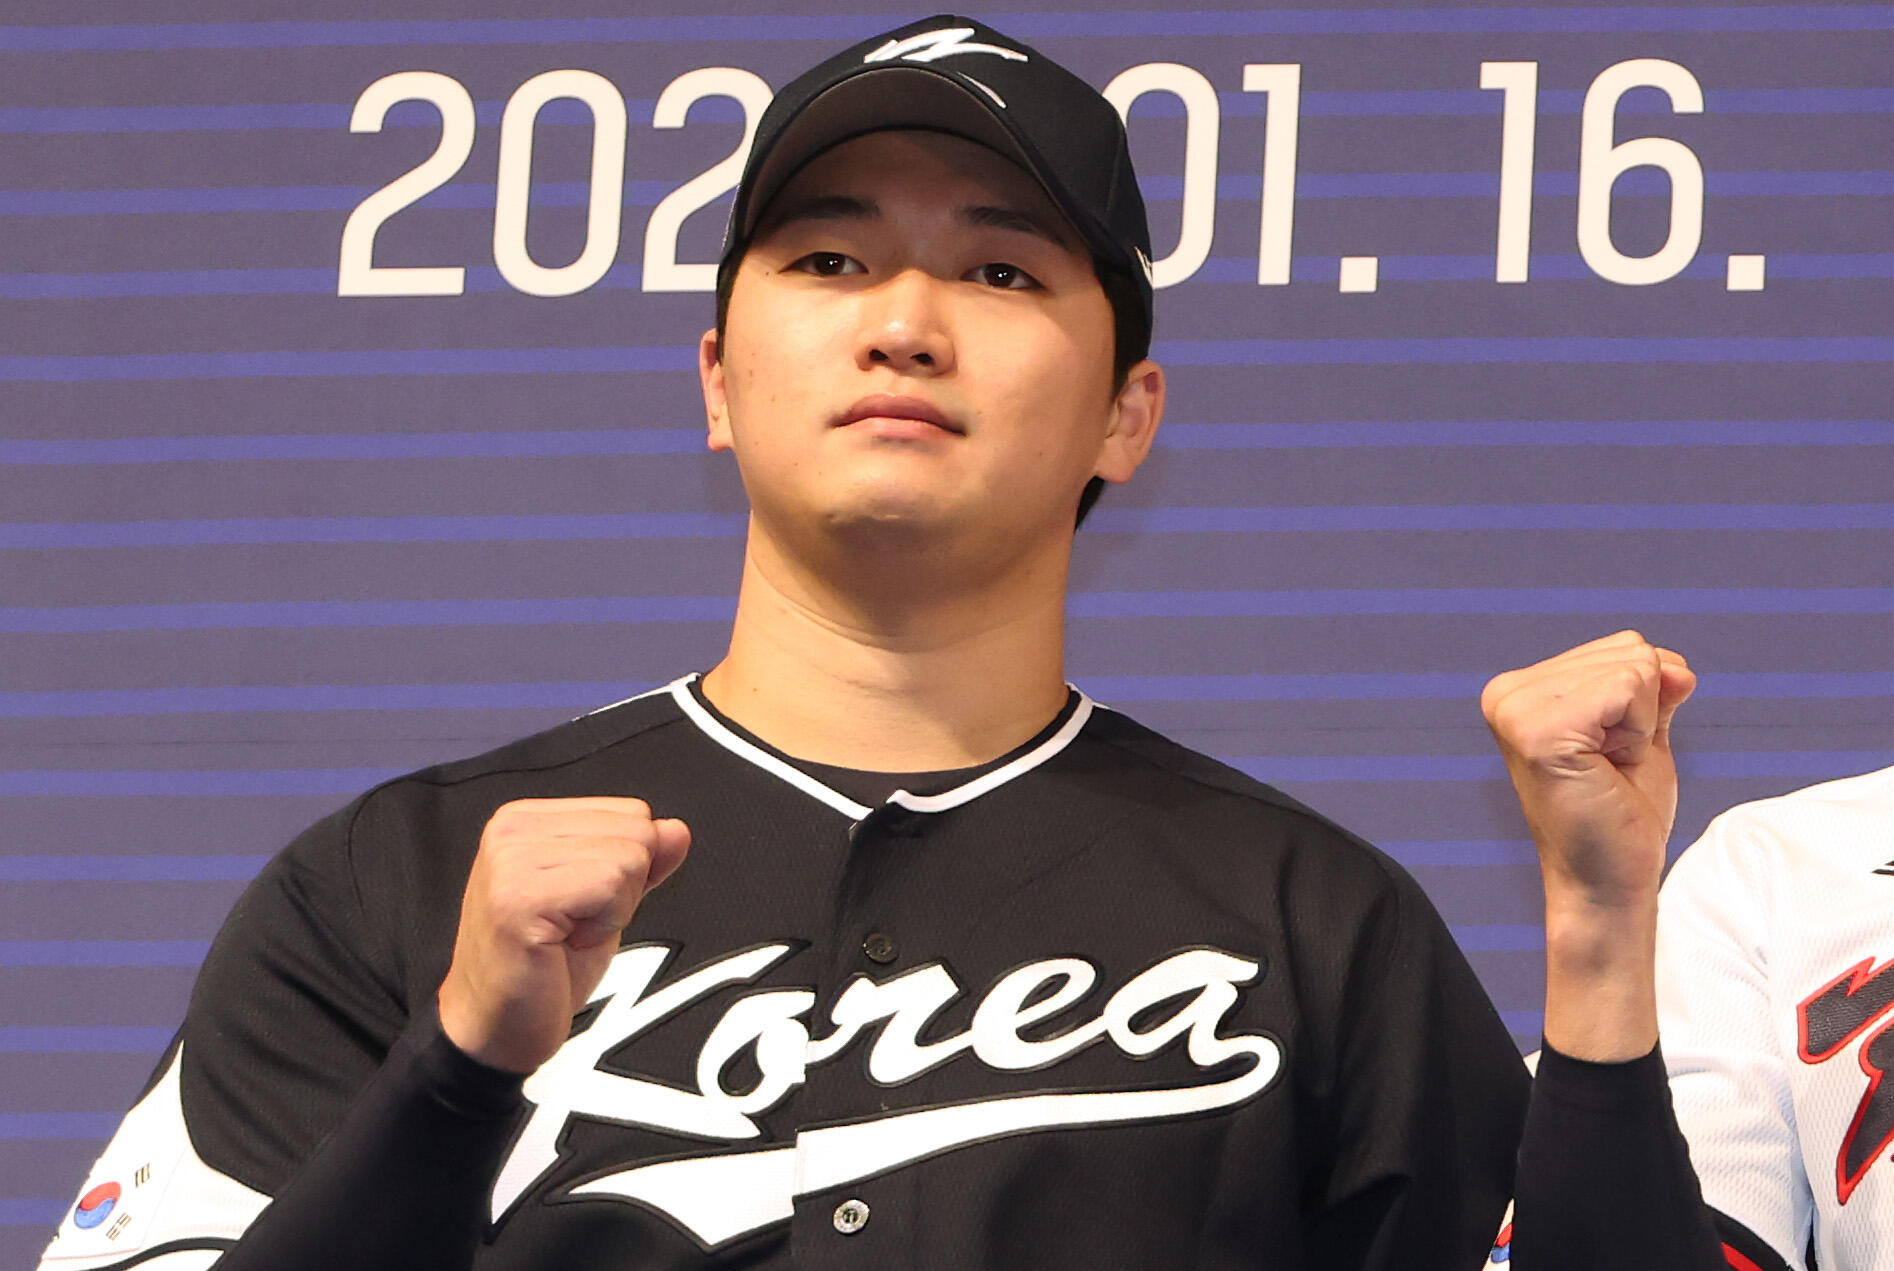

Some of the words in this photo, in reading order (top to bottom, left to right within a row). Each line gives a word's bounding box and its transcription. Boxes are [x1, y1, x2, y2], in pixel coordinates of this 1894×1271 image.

[339, 68, 773, 296] 202
[1481, 60, 1764, 290] 16.
[489, 940, 1283, 1247] Korea
